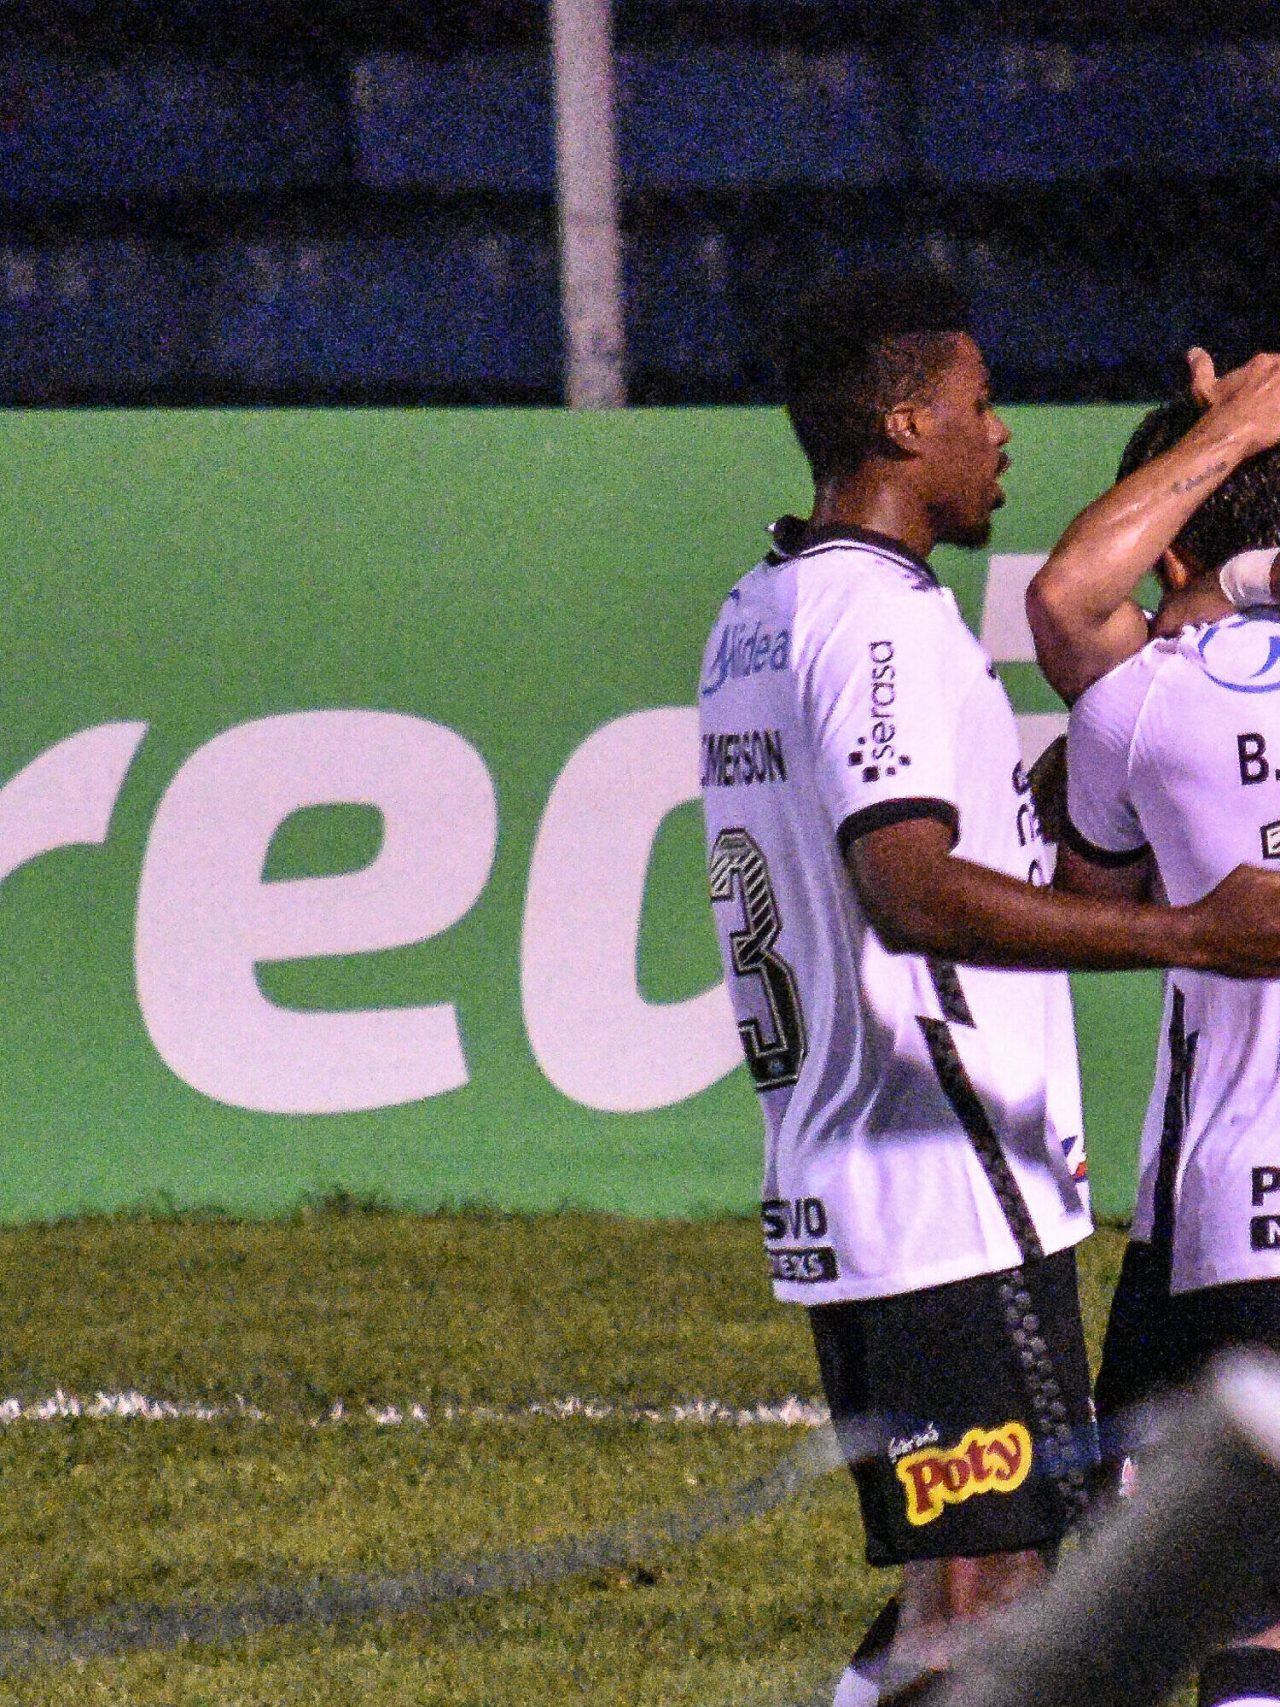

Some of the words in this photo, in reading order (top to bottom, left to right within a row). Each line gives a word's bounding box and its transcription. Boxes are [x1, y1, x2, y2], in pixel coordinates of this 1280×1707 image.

[868, 641, 896, 760] serasa
[712, 827, 808, 1092] 3
[903, 1430, 1025, 1517] Poty
